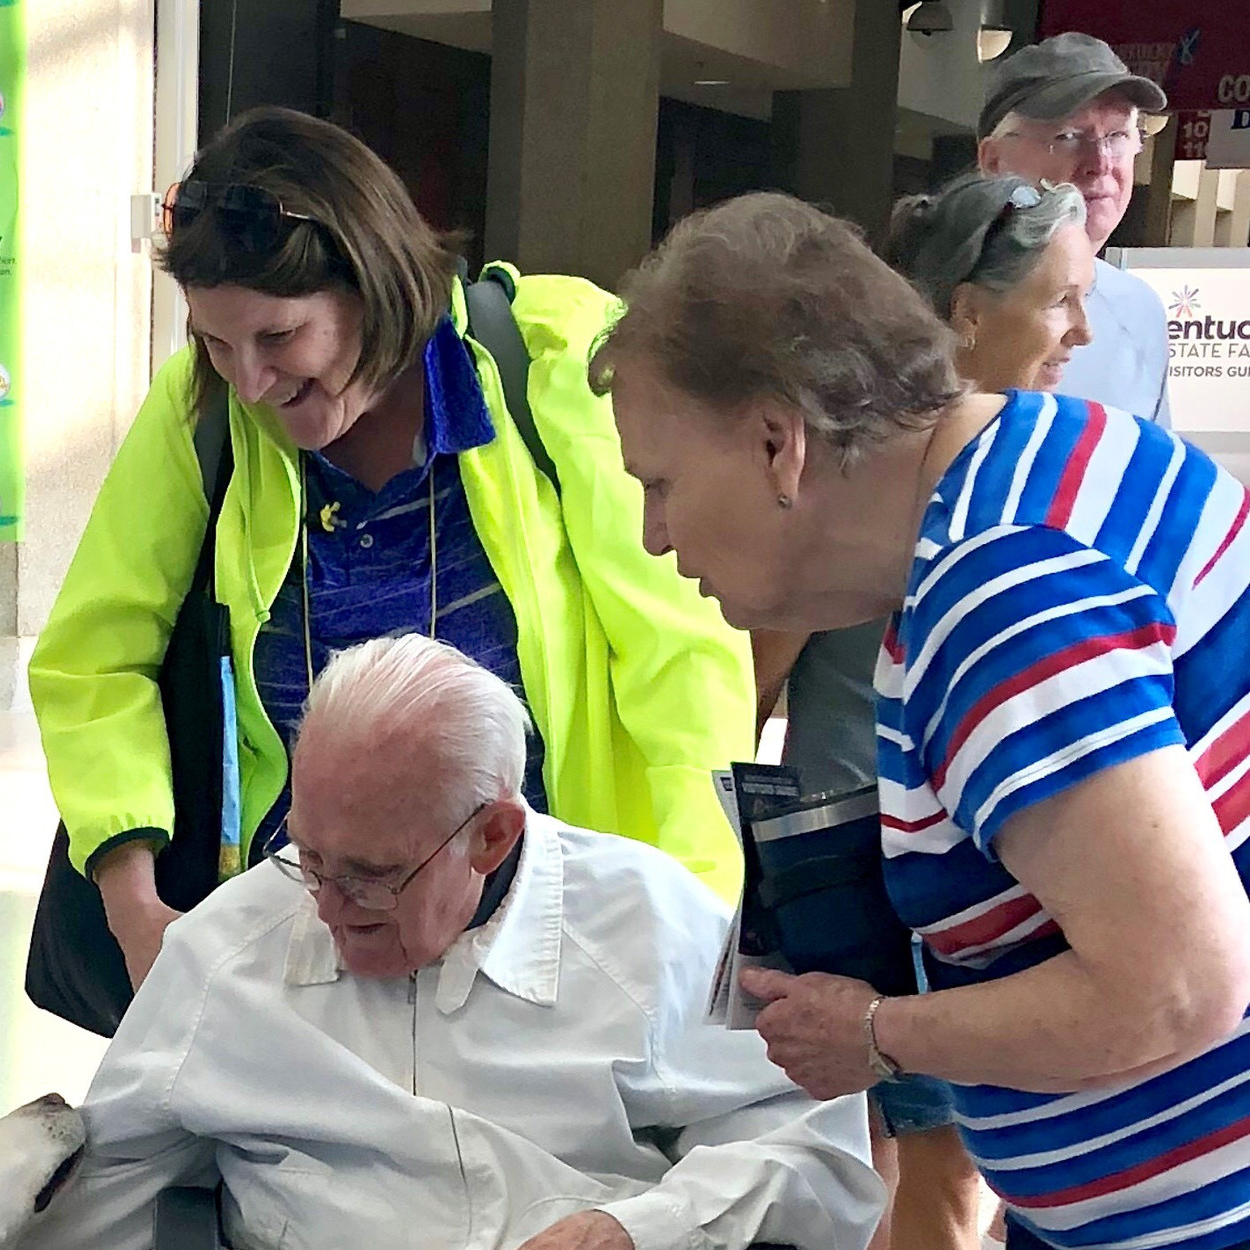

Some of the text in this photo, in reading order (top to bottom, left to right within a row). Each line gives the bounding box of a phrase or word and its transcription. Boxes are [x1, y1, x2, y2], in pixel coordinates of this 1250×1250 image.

[1184, 121, 1209, 138] 10
[1167, 314, 1250, 340] entuc
[1168, 342, 1222, 358] STATE
[1169, 365, 1223, 378] ISITORS
